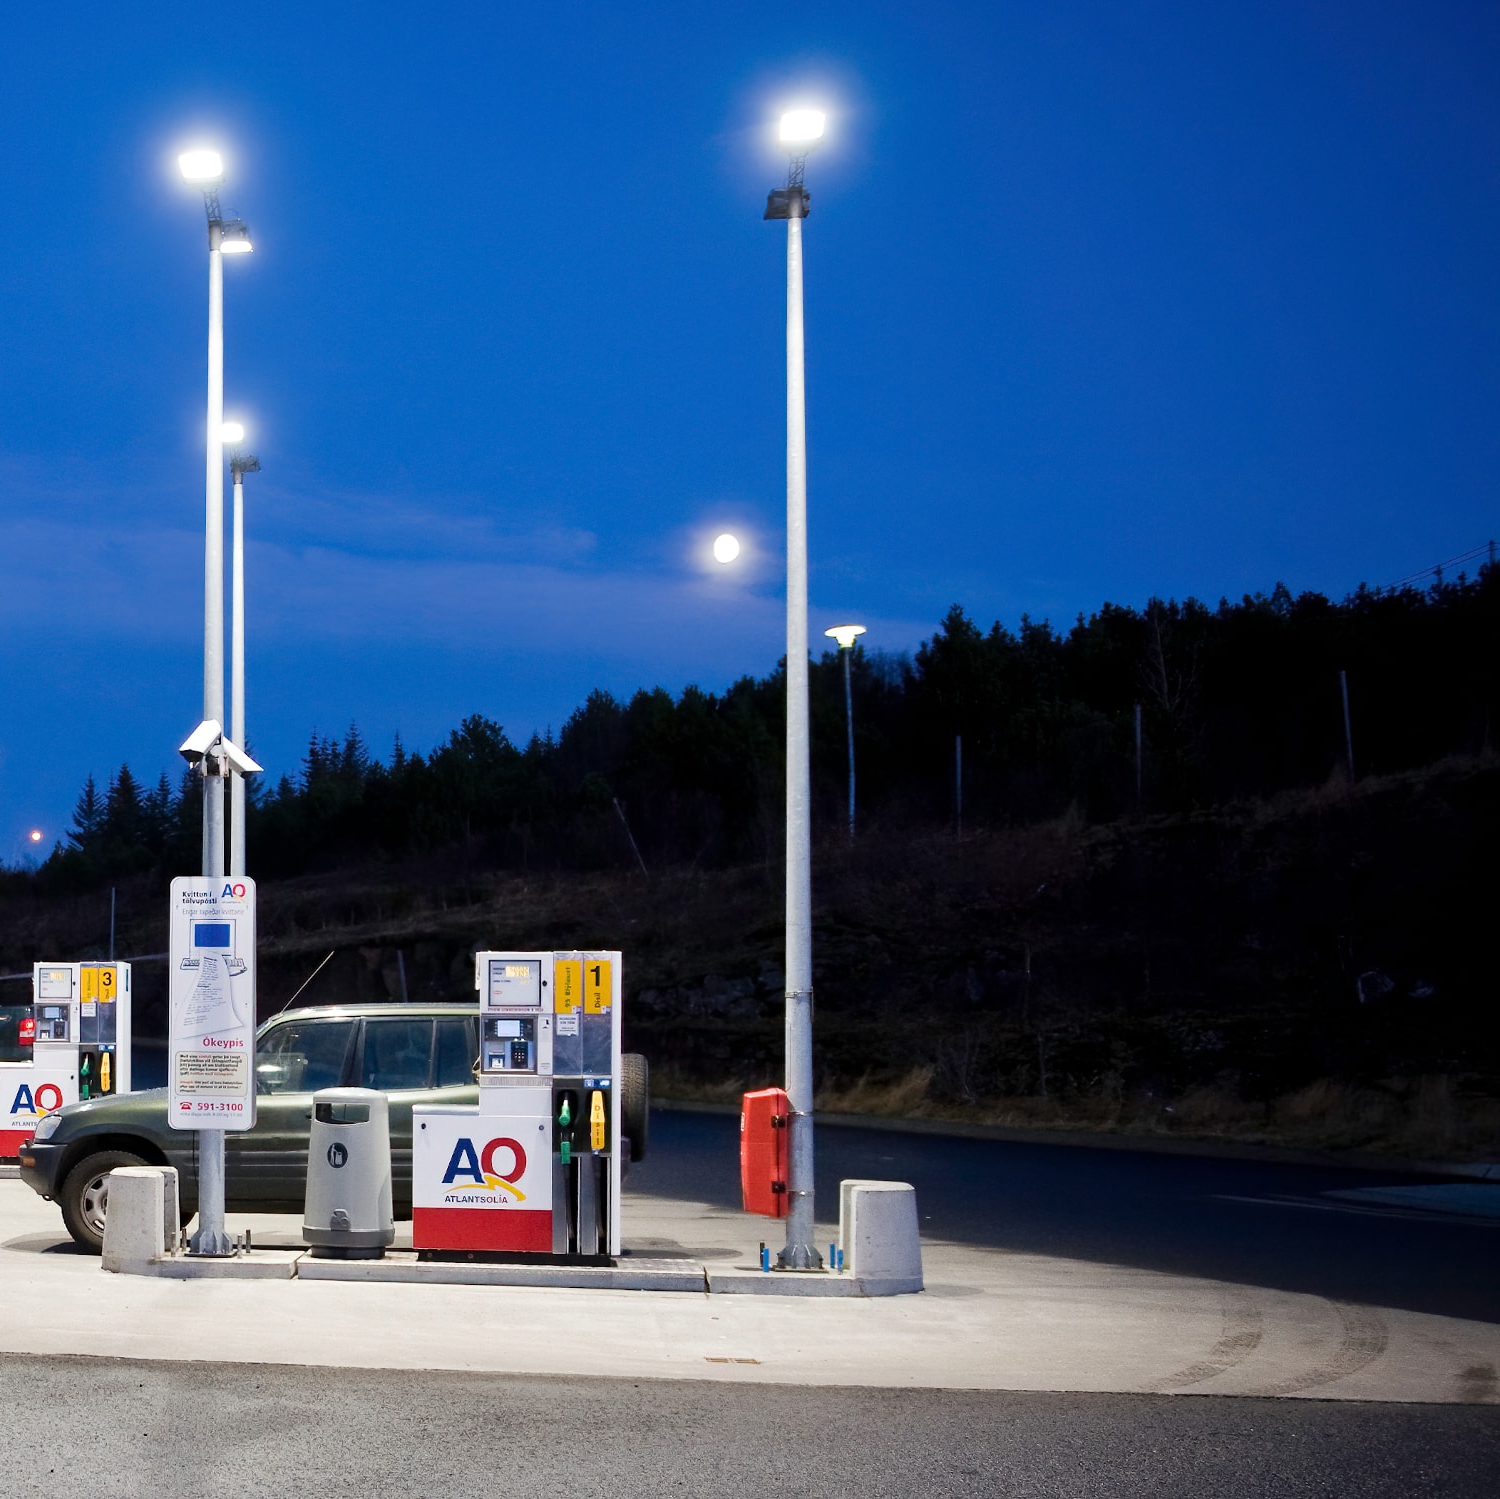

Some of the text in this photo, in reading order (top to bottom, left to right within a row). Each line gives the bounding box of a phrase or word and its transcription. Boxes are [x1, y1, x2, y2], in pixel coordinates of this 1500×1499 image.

[102, 971, 112, 986] 3
[590, 965, 601, 987] 1
[203, 1036, 244, 1049] Ókeypis
[197, 1102, 243, 1111] 591-3100
[444, 1194, 508, 1204] ATLANTSOLÍA
